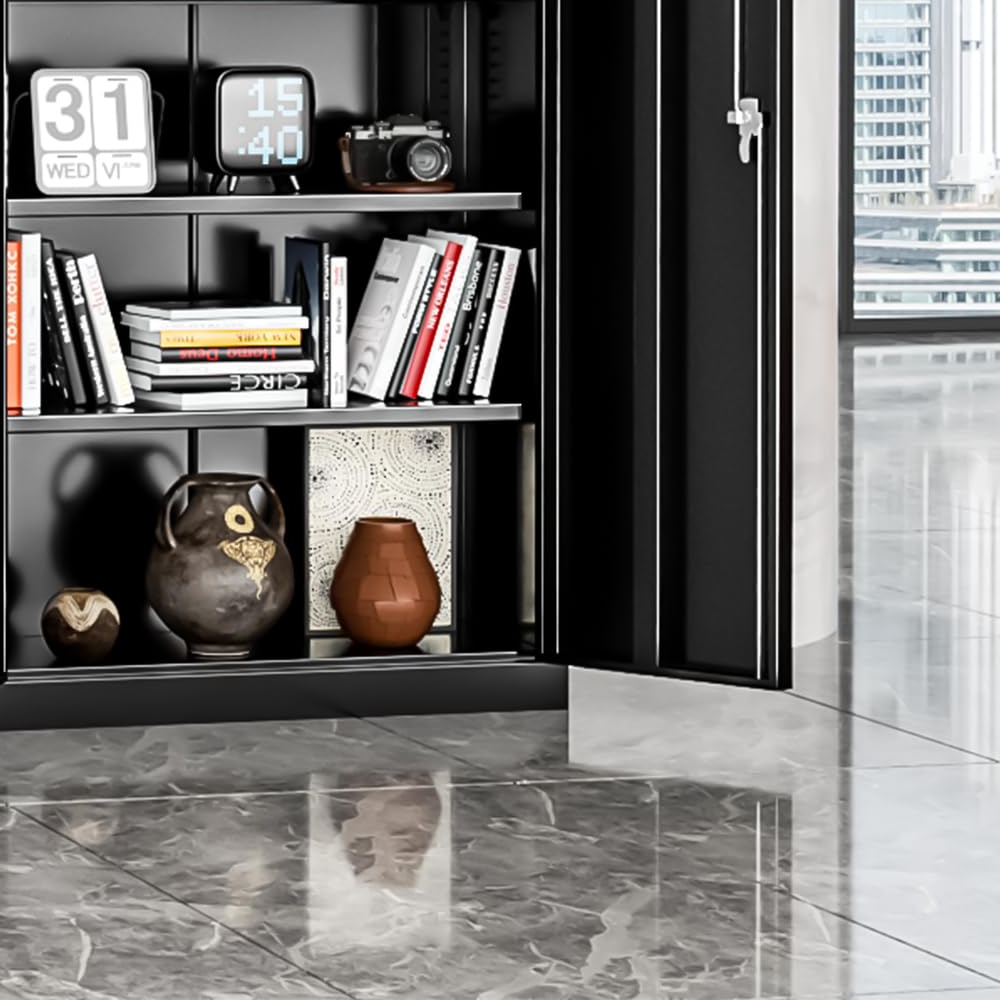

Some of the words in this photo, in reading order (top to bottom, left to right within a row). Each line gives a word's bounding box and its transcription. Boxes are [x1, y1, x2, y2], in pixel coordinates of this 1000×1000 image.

[247, 77, 303, 117] 15
[47, 163, 90, 179] WED
[102, 162, 120, 179] VI
[66, 259, 85, 306] Perth
[435, 259, 456, 306] ORLEANS
[462, 260, 483, 312] Brisbane
[178, 348, 219, 361] Deus
[226, 347, 277, 360] Homo
[230, 373, 302, 391] CIRCE
